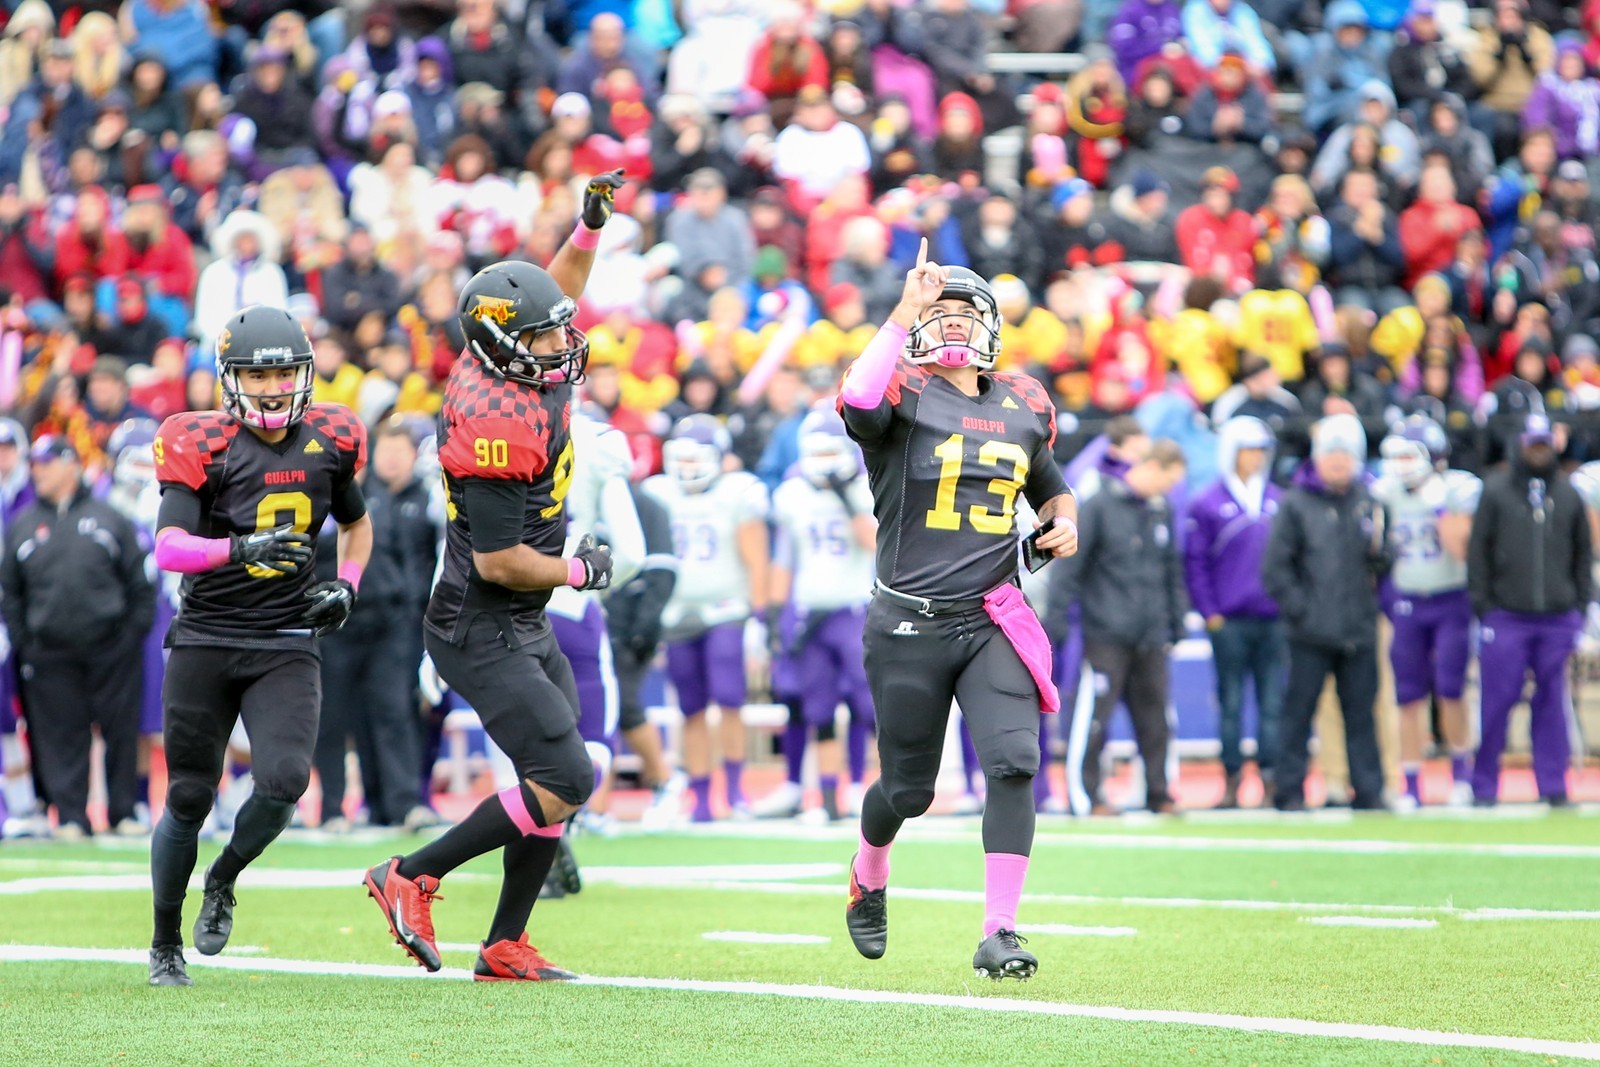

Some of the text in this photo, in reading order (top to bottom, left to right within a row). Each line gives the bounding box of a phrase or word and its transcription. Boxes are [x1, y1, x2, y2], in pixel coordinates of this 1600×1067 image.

[962, 416, 1005, 434] GUELPH
[474, 437, 509, 467] 90
[264, 470, 306, 485] GUELPH
[925, 433, 1030, 535] 13
